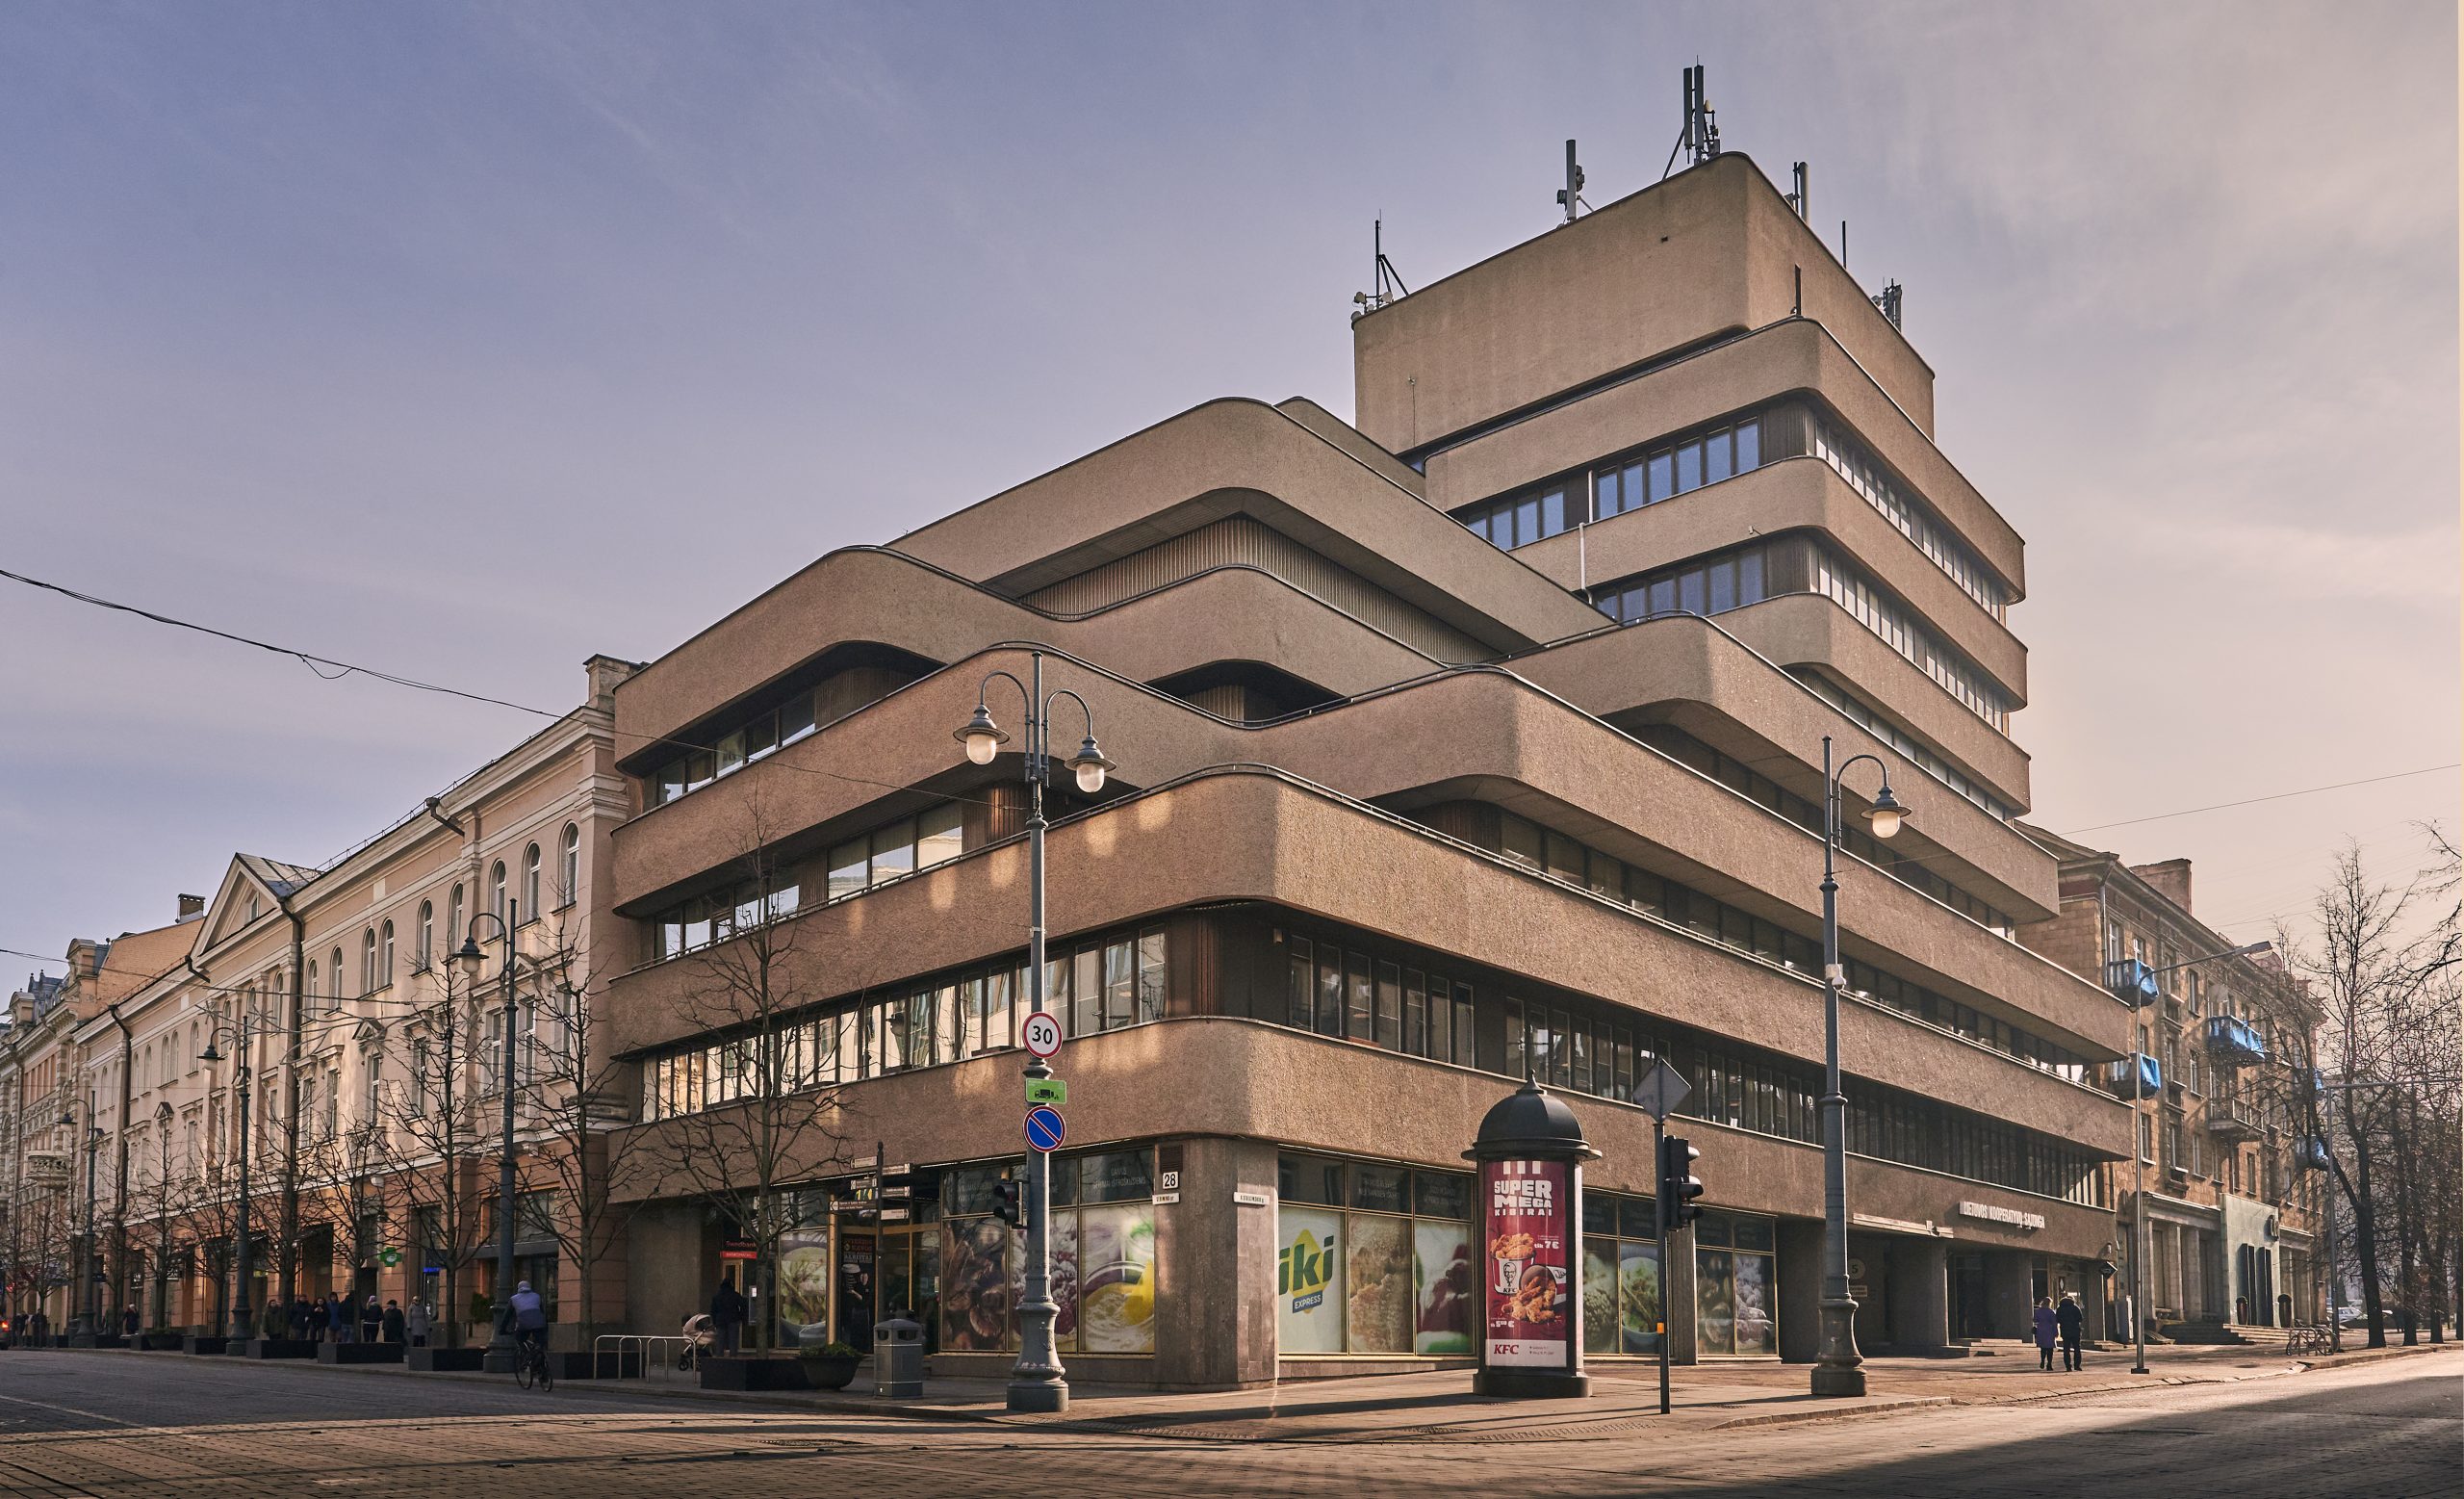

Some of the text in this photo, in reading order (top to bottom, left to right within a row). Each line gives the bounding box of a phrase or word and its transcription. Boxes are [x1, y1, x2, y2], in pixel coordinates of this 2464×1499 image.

[1032, 1025, 1053, 1045] 30
[1165, 1173, 1176, 1187] 28
[1494, 1179, 1553, 1200] SUPER
[1494, 1194, 1553, 1208] MEGA
[1494, 1208, 1553, 1217] KIBIRAI
[1964, 1201, 1988, 1219] LIETUVOS
[1278, 1235, 1334, 1296] iki
[1851, 1264, 1859, 1274] 5
[1294, 1294, 1322, 1309] EXPRESS
[1494, 1344, 1520, 1355] KFC
